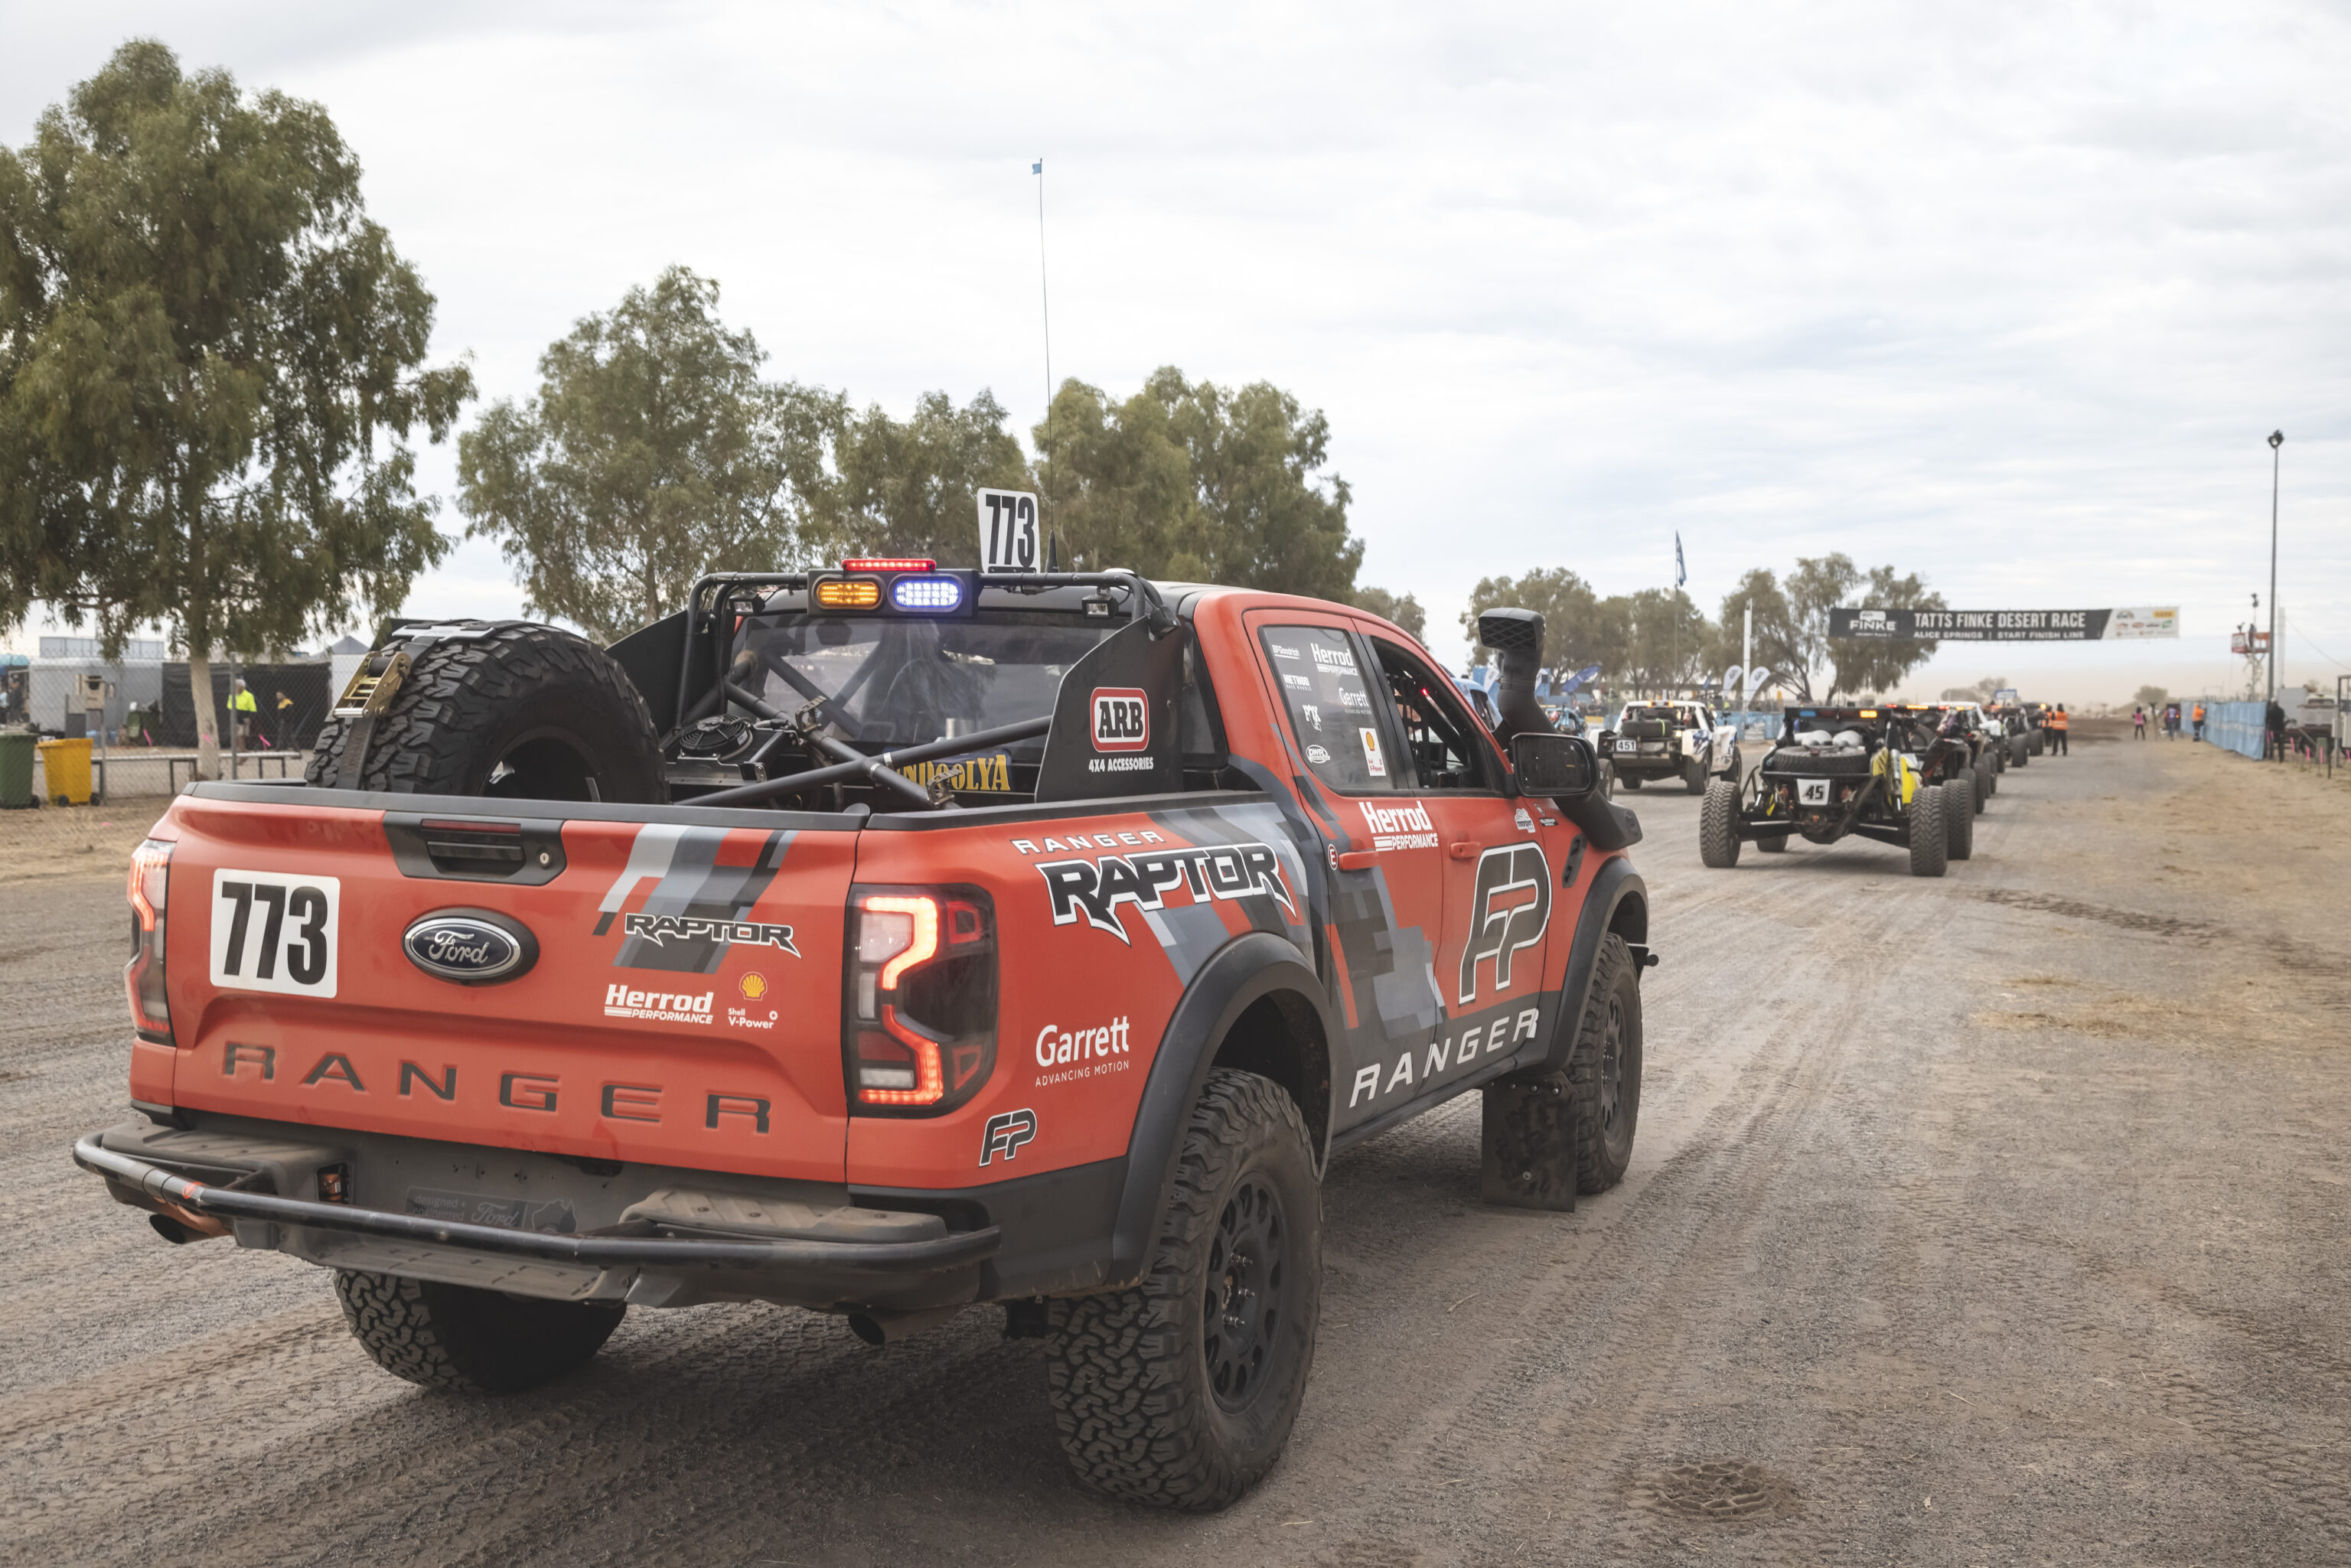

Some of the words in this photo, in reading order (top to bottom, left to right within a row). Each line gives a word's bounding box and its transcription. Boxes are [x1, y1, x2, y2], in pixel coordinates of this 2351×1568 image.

[986, 494, 1035, 567] 773
[1849, 620, 1896, 631] FINKE
[1915, 613, 1953, 628] TATTS
[1956, 613, 1994, 628] FINKE
[1997, 613, 2047, 628] DESERT
[2052, 612, 2086, 628] RACE
[1310, 643, 1355, 667] Herrod
[1283, 673, 1310, 686] METHOD
[1339, 687, 1369, 707] Garrett
[1098, 701, 1143, 738] ARB
[1618, 741, 1635, 750] 451
[1089, 759, 1106, 772] 4X4
[1108, 757, 1153, 771] ACCESSORIES
[1802, 784, 1825, 800] 45
[1358, 800, 1433, 833] Herrod
[1010, 830, 1166, 855] RANGER
[1391, 833, 1439, 850] PERFORMANCE
[1330, 849, 1337, 865] E
[1034, 843, 1297, 948] RAPTOR
[221, 881, 328, 986] 773
[624, 912, 802, 959] RAPTOR
[428, 929, 491, 964] Ford
[605, 983, 714, 1013] Herrod
[631, 1009, 713, 1024] PERFORMANCE
[728, 1008, 745, 1016] Shell
[728, 1016, 774, 1029] V-Power
[1035, 1015, 1130, 1067] Garrett
[1349, 1008, 1539, 1108] RANGER
[1035, 1068, 1091, 1087] ADVANCING
[1094, 1060, 1130, 1075] MOTION
[223, 1042, 771, 1135] RANGER
[415, 1194, 458, 1208] designed
[471, 1202, 520, 1227] Ford
